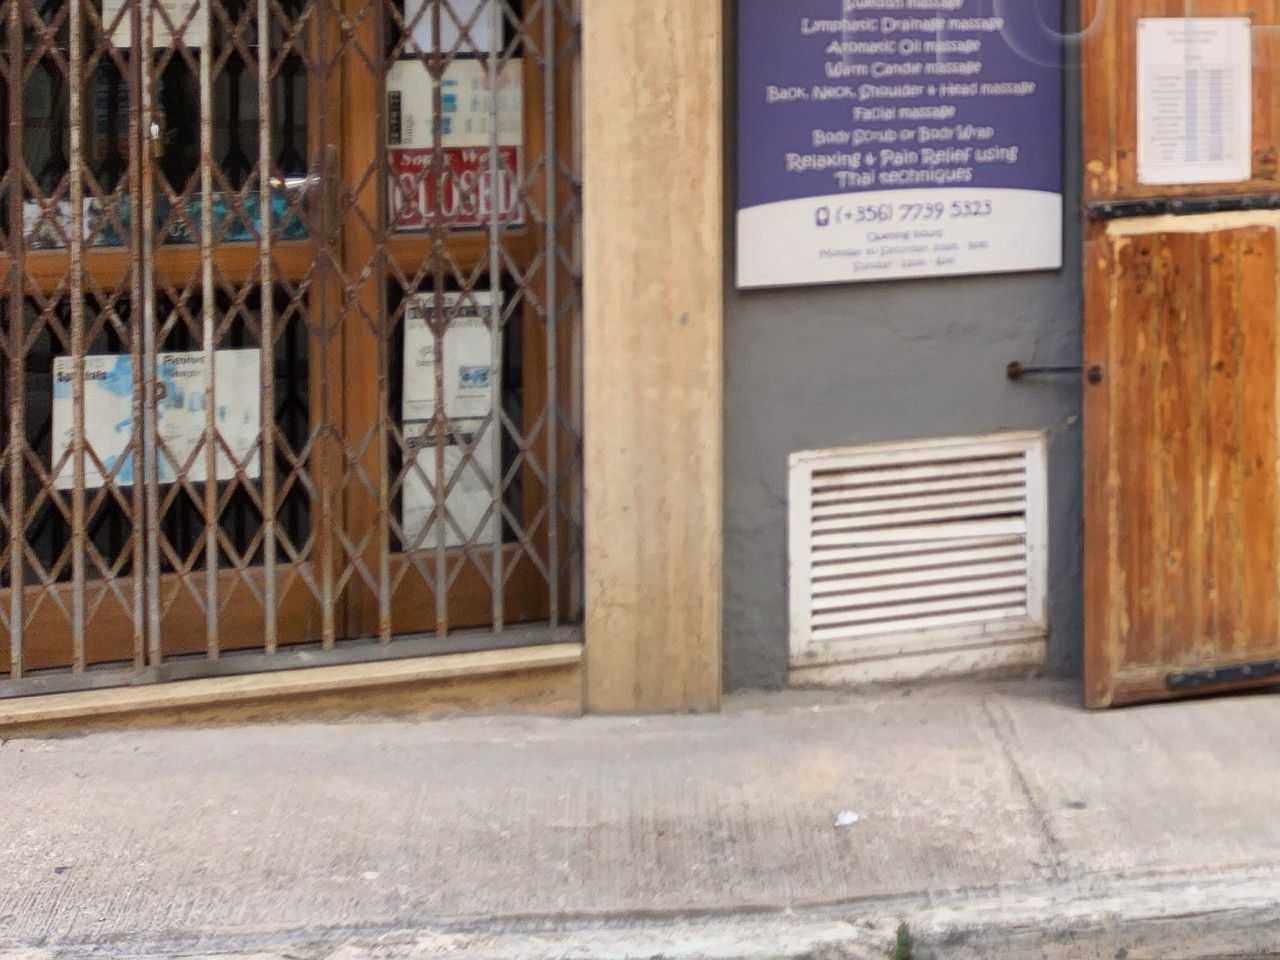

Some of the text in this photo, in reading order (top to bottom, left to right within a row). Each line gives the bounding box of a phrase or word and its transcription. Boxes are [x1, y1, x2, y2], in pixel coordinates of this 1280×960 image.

[880, 16, 946, 34] Drainage
[948, 16, 1005, 33] massage
[825, 38, 981, 56] Aromatic Oil massage
[825, 60, 982, 79] Warm Candle massage
[858, 83, 924, 101] Shoulder
[939, 82, 978, 97] Head
[980, 80, 1036, 95] massage
[852, 104, 956, 122] Facial massage
[812, 124, 994, 146] Body Scrub or Body Wrap
[785, 151, 862, 171] Relaxing
[880, 148, 919, 168] Pain
[920, 146, 973, 166] Relief
[975, 145, 1019, 164] using
[834, 167, 974, 189] Thai techniques
[394, 170, 518, 219] CLOSED
[834, 199, 993, 224] (+356) 7739 5323
